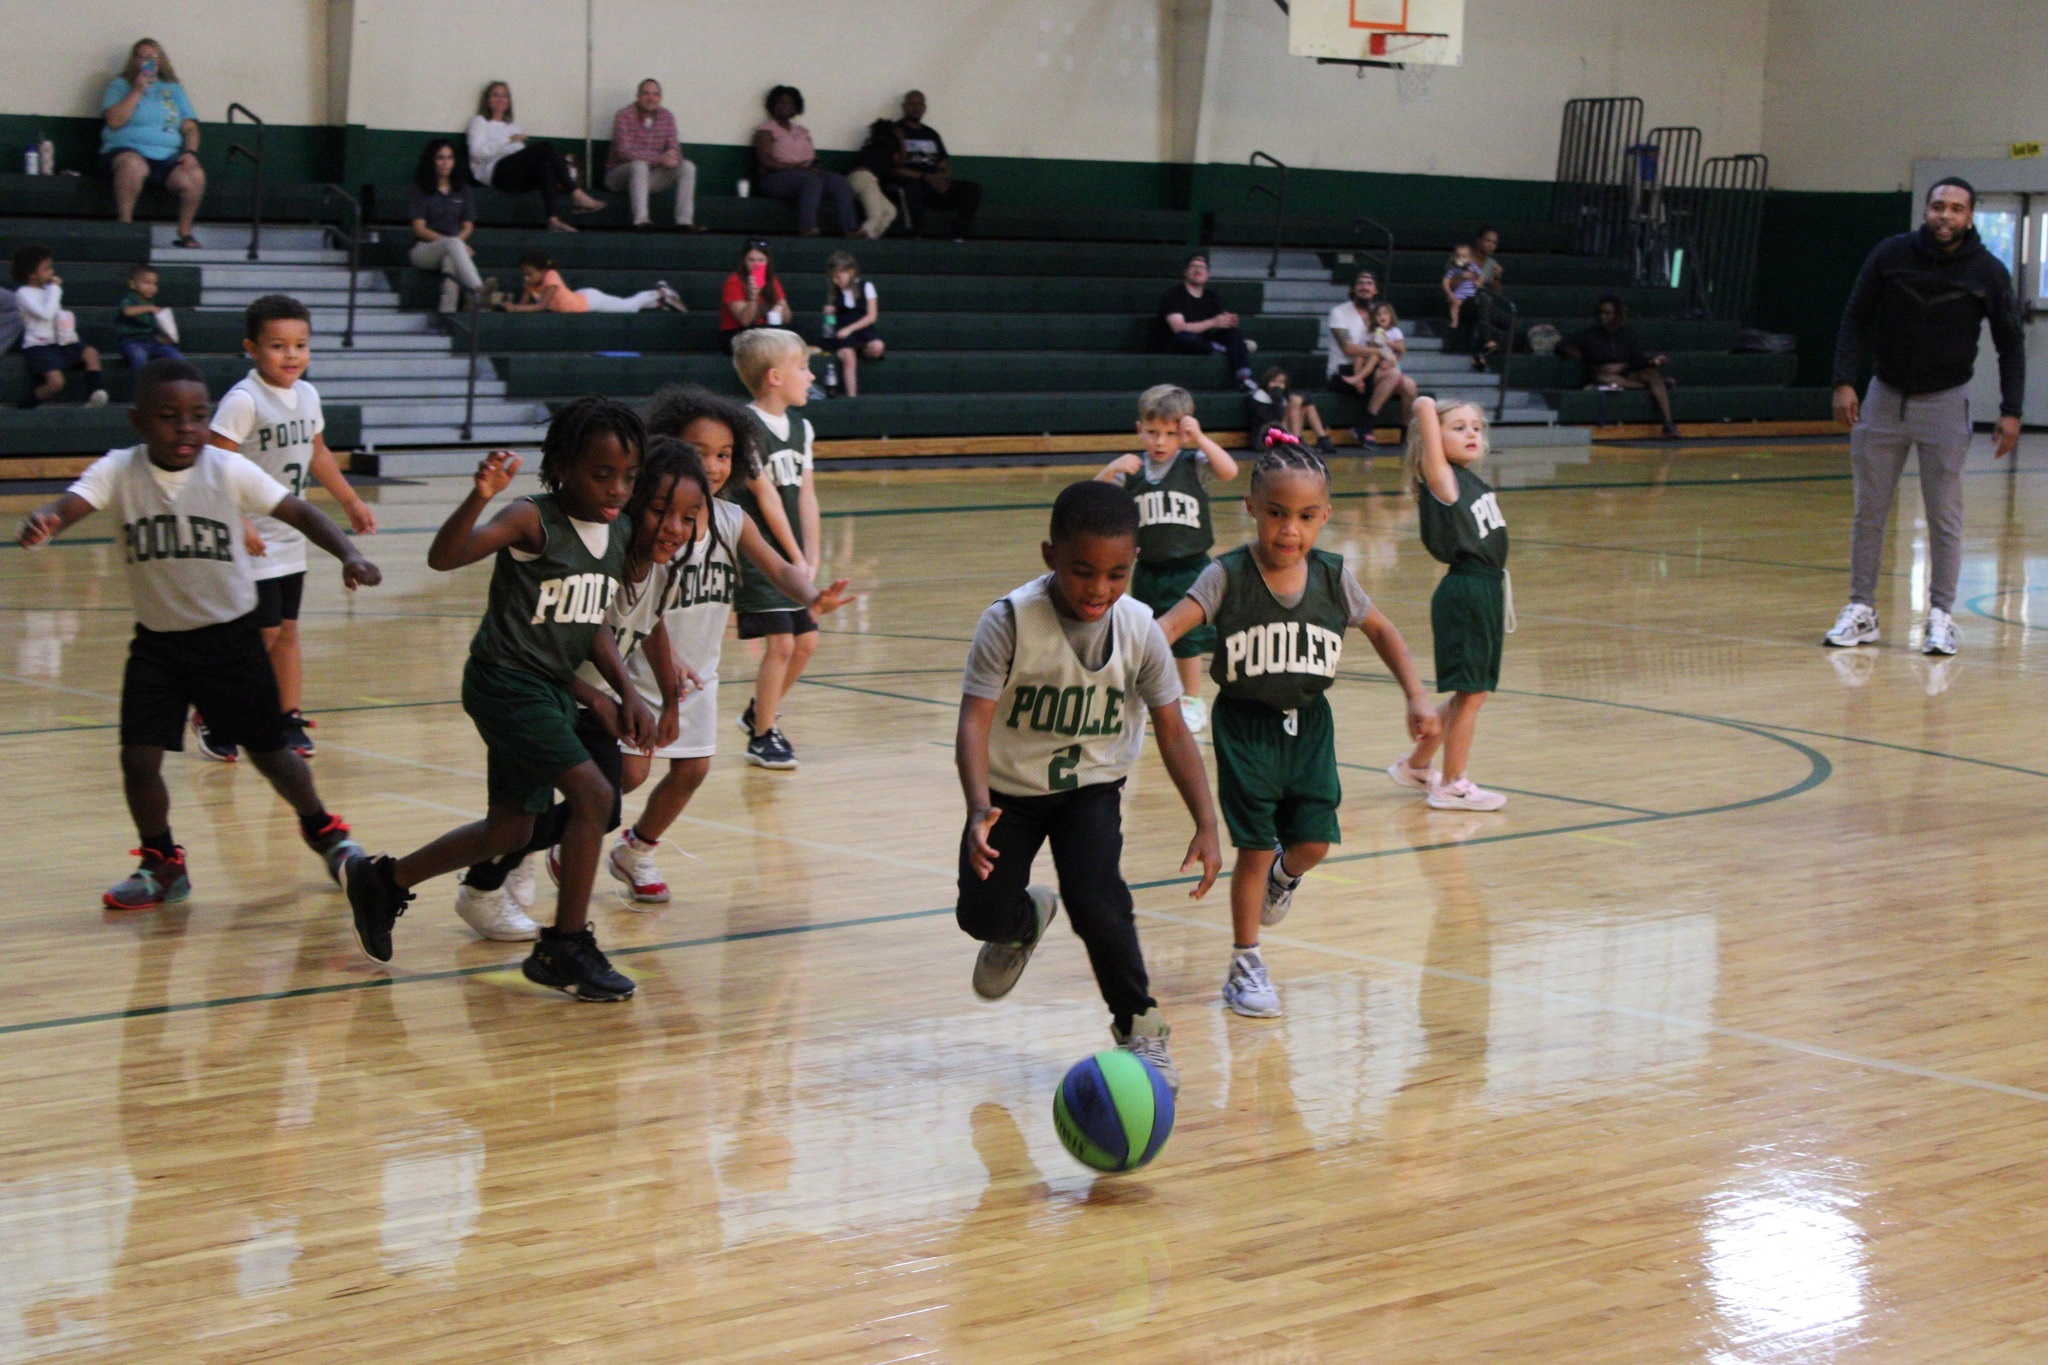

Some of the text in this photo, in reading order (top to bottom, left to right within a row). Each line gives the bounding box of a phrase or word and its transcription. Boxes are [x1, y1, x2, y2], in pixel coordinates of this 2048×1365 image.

[258, 419, 316, 452] POOL
[1225, 621, 1343, 683] POOLER
[1006, 684, 1125, 736] POOLE
[1048, 743, 1082, 790] 2
